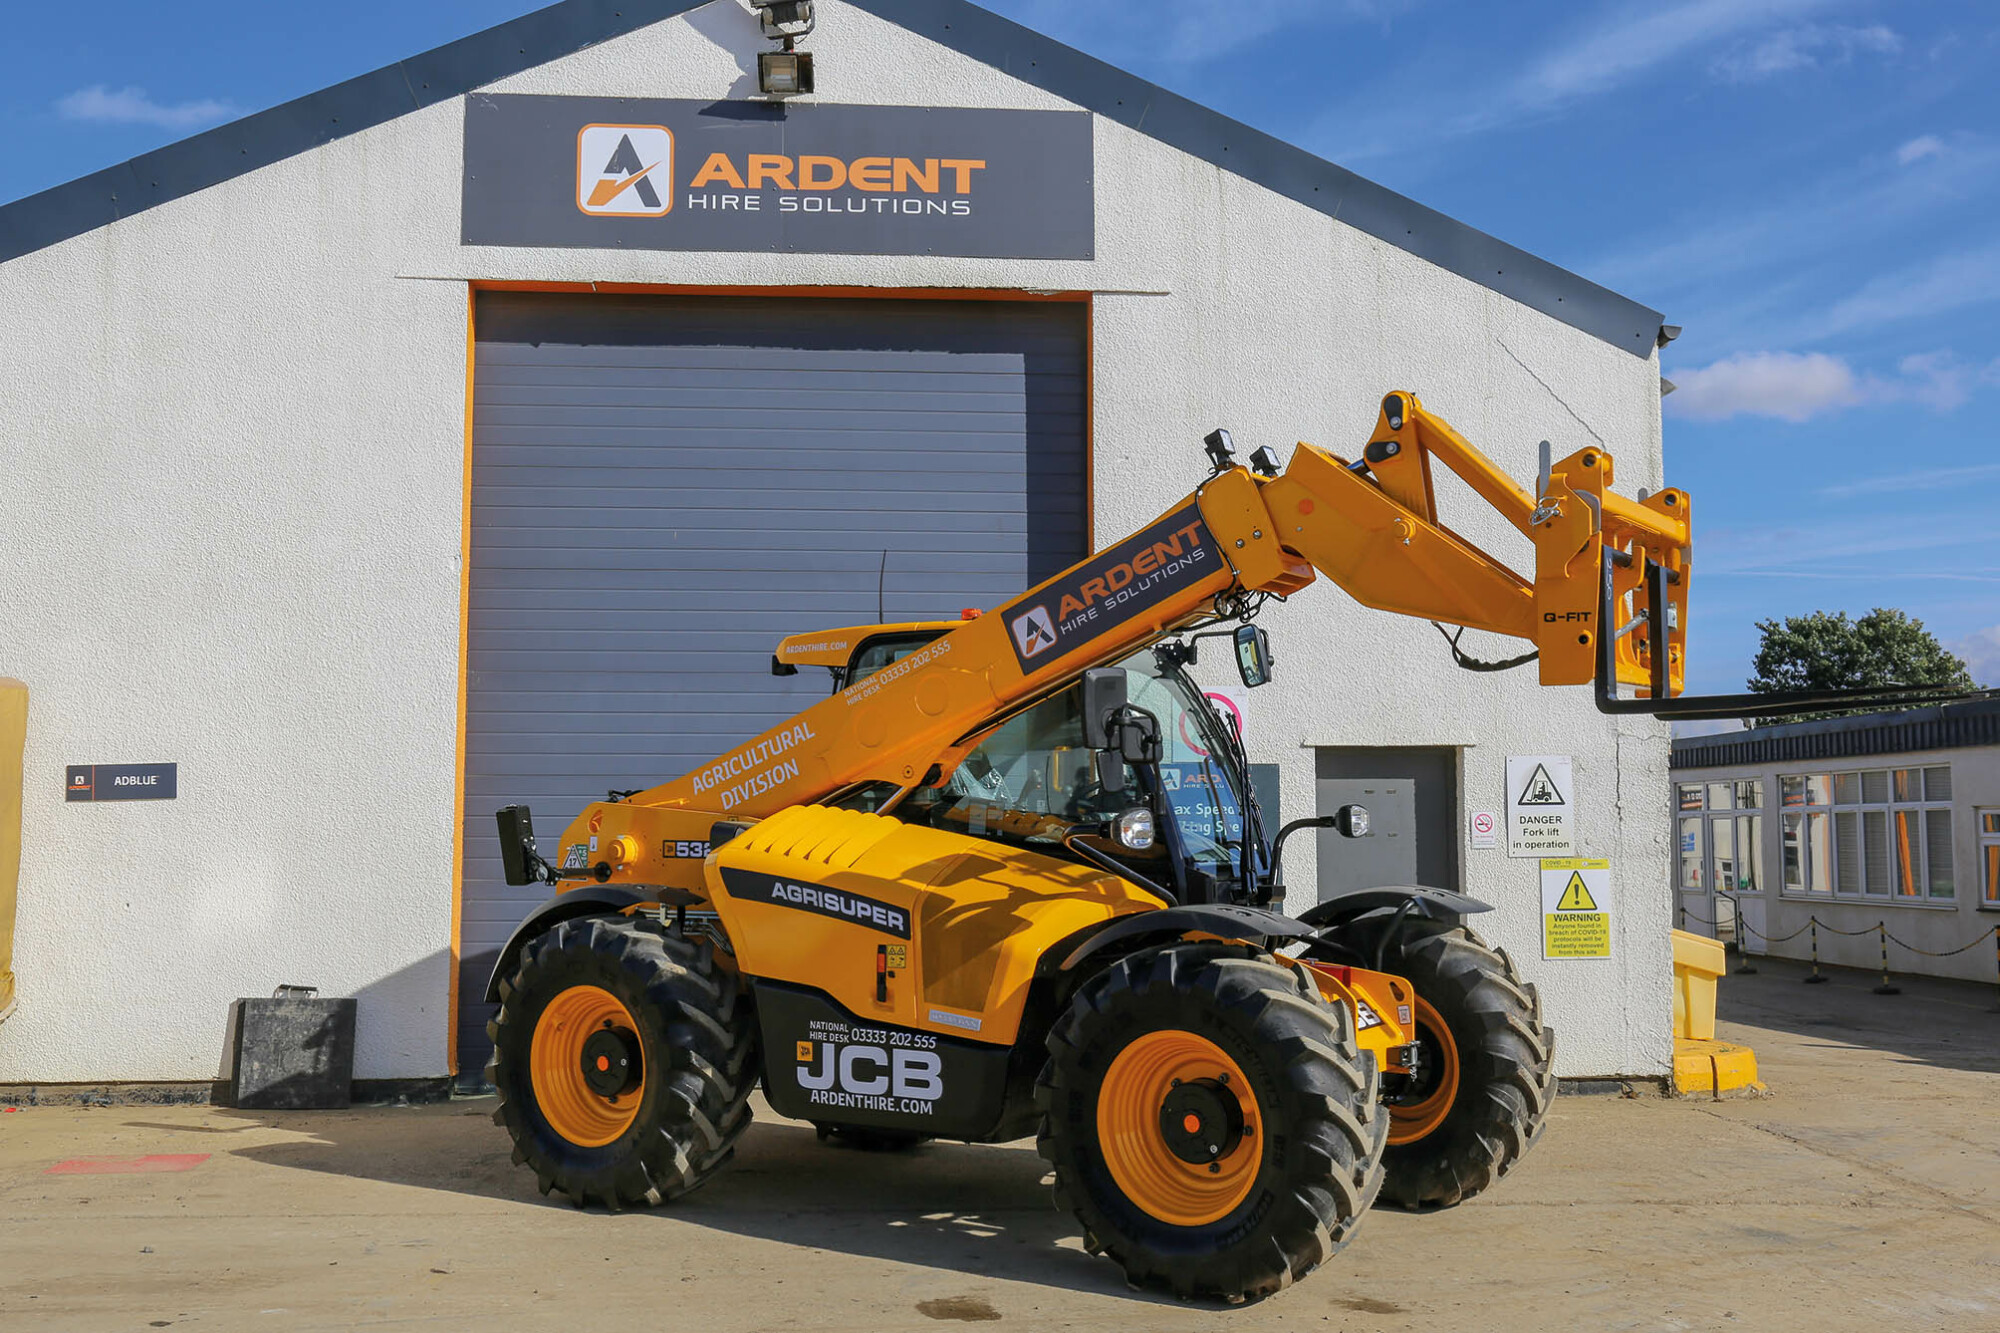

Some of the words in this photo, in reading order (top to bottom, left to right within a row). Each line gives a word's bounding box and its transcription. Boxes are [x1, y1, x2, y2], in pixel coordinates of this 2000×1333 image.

[689, 152, 986, 195] ARDENT
[688, 194, 760, 211] HIRE
[779, 196, 971, 216] SOLUTIONS
[1058, 519, 1202, 623] ARDENT
[1060, 609, 1099, 635] HIRE
[1104, 548, 1206, 611] SOLUTIONS
[1543, 612, 1592, 622] Q-FIT
[785, 641, 848, 654] ARDENTHIRE.COM
[843, 676, 878, 698] NATIONAL
[879, 662, 911, 685] 03333
[912, 652, 931, 669] 202
[931, 640, 951, 658] 555
[692, 722, 816, 796] AGRICULTURAL
[114, 775, 157, 786] ADBLUE
[720, 758, 800, 811] DIVISION
[1173, 805, 1192, 815] ax
[1519, 816, 1562, 825] DANGER
[1522, 828, 1545, 837] Fork
[1547, 828, 1560, 837] lift
[1513, 841, 1522, 849] in
[1524, 841, 1570, 850] operation
[771, 881, 904, 931] AGRISUPER
[1553, 913, 1601, 922] WARNING
[809, 1020, 849, 1033] NATIONAL
[851, 1028, 887, 1044] 03333
[889, 1031, 911, 1046] 202
[913, 1034, 937, 1049] 555
[809, 1030, 827, 1041] HIRE
[829, 1033, 850, 1043] DESK
[796, 1042, 943, 1101] JCB
[810, 1089, 933, 1115] ARDENTHIRE.COM
